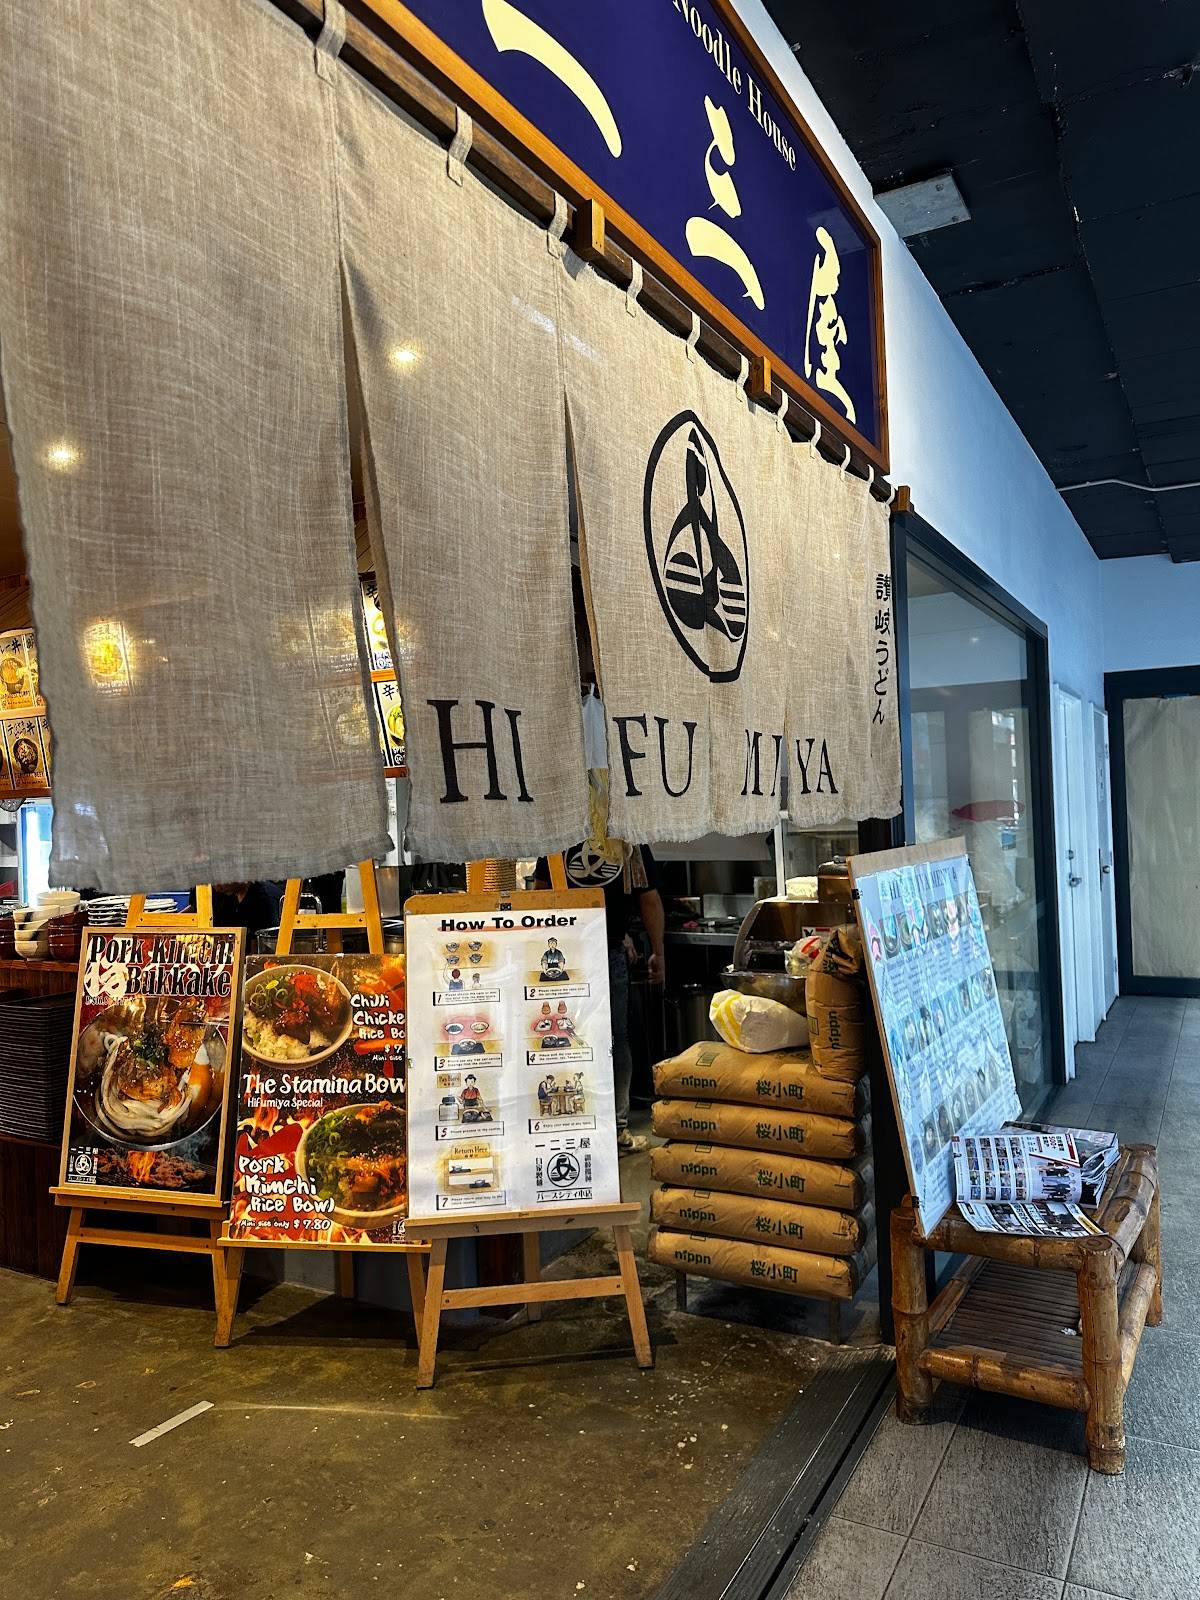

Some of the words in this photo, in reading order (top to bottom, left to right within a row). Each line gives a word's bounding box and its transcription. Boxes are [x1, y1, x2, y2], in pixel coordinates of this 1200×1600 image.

[746, 73, 796, 171] House
[427, 699, 534, 804] HI
[613, 713, 698, 799] FU
[441, 919, 486, 932] How
[491, 917, 515, 930] To
[521, 915, 577, 928] Order
[89, 934, 146, 965] Pork
[151, 934, 235, 966] Kimchi
[124, 964, 232, 998] Bukkake
[358, 1028, 386, 1040] Rice
[828, 1011, 842, 1050] nippn
[243, 1073, 276, 1094] The
[280, 1073, 363, 1094] Stamina
[681, 1075, 718, 1089] nippn
[755, 1079, 805, 1101] 桜小町
[291, 1097, 324, 1111] Special
[680, 1117, 717, 1132] nippn
[755, 1122, 805, 1143] 桜小町
[535, 1137, 592, 1151] 一二三屋
[238, 1154, 286, 1175] Pork
[680, 1162, 718, 1177] nippn
[244, 1173, 318, 1196] Kimchi
[757, 1168, 806, 1193] 桜小町
[249, 1195, 287, 1213] Rice
[240, 1218, 256, 1228] Mini
[273, 1219, 291, 1231] only
[303, 1217, 333, 1231] 7.80
[678, 1207, 717, 1223] nippn
[755, 1215, 805, 1240] 桜小町
[674, 1249, 712, 1266] nippn
[750, 1259, 799, 1284] 桜小町
